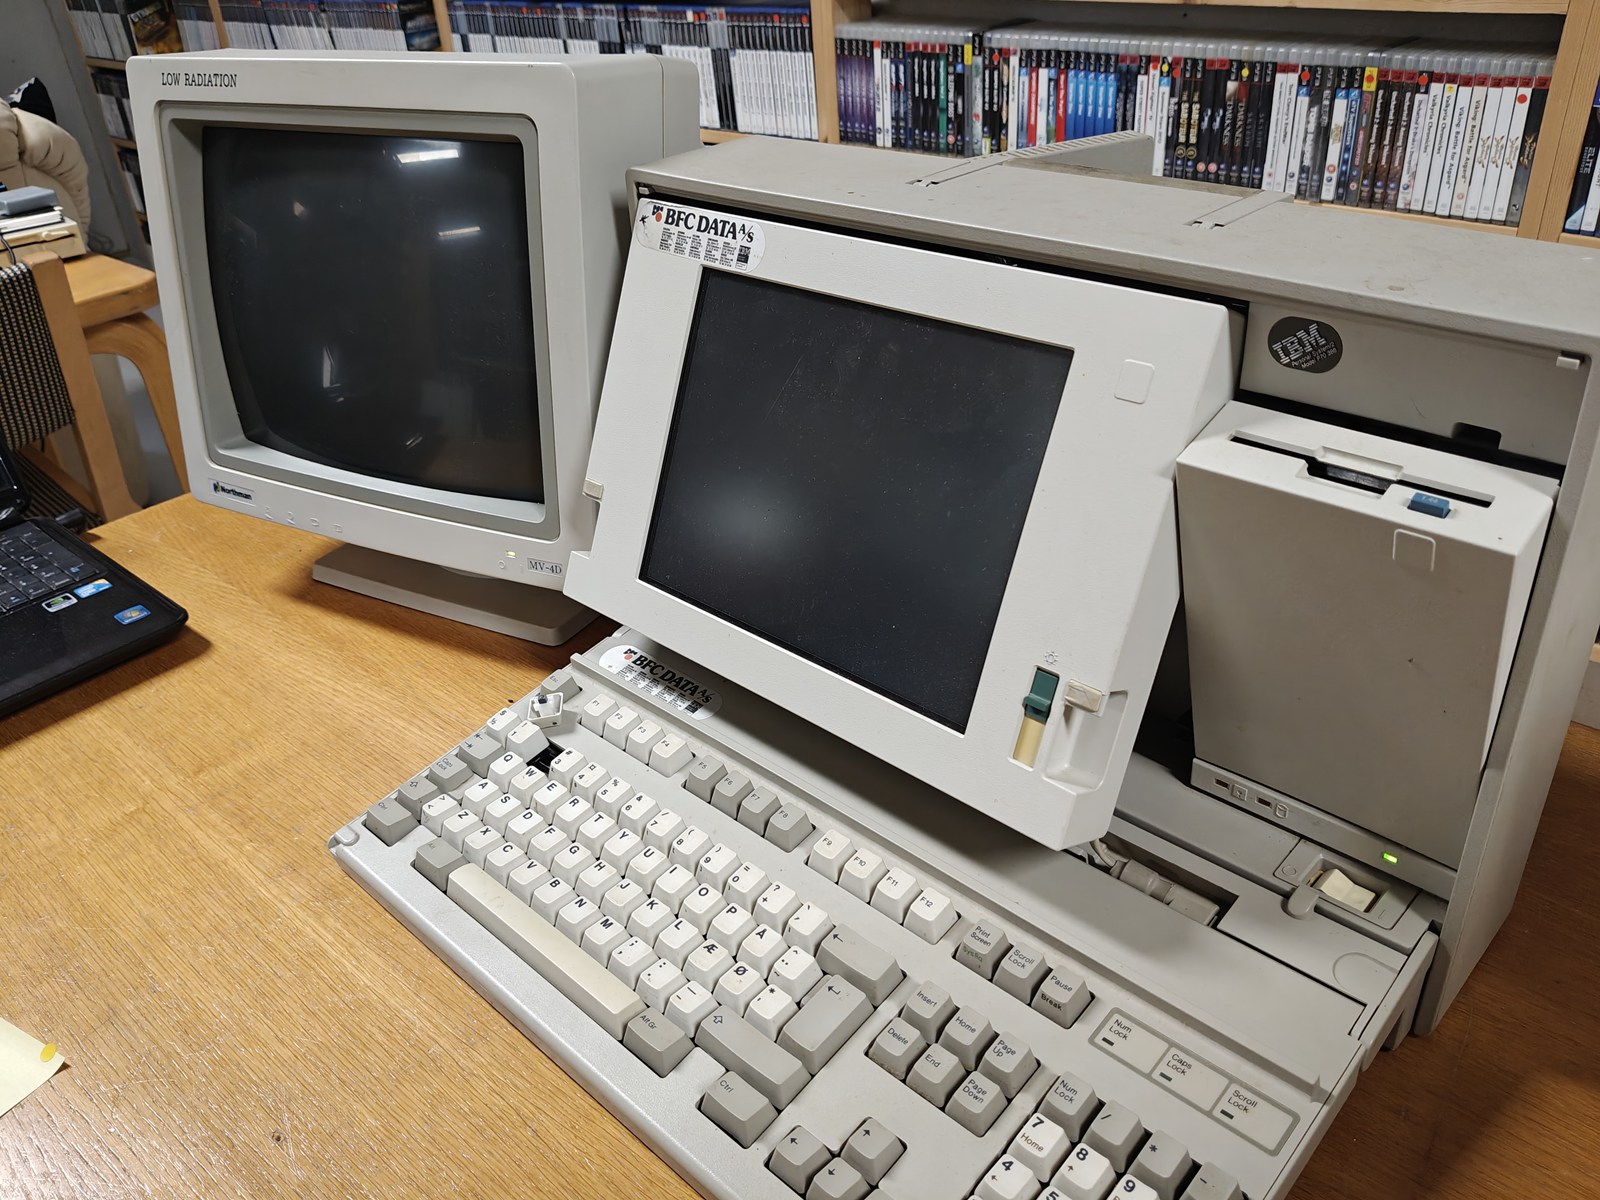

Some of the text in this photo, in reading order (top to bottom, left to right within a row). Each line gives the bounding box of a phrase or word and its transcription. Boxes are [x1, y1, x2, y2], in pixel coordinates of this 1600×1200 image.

[162, 73, 237, 87] LOW RADIATION
[1178, 102, 1189, 143] SABOTEUR
[1189, 103, 1200, 144] SABOTEUR
[1423, 94, 1438, 153] Valkyria Chronicles
[1437, 95, 1452, 155] Valkyria Chronicles
[1468, 124, 1476, 143] Battle
[1452, 131, 1460, 150] Battle
[1584, 147, 1596, 174] ELITE
[664, 208, 754, 243] BFC DATA A/S
[1272, 323, 1326, 364] IBM
[530, 561, 562, 574] MV-4D
[631, 655, 665, 676] BFC
[658, 670, 699, 696] DATA
[614, 712, 622, 720] F2
[637, 726, 646, 734] F3
[661, 739, 670, 747] F4
[503, 754, 513, 763] Q
[525, 768, 536, 777] W
[478, 782, 489, 790] A
[547, 783, 557, 791] E
[723, 776, 734, 786] F6
[501, 795, 511, 804] S
[569, 798, 580, 807] R
[750, 792, 761, 801] F7
[458, 811, 469, 819] Z
[522, 812, 533, 820] D
[594, 814, 604, 822] T
[778, 809, 789, 819] F8
[480, 827, 492, 836] X
[544, 827, 556, 835] F
[619, 831, 629, 840] Y
[822, 837, 833, 846] F9
[502, 844, 513, 853] C
[569, 846, 580, 854] G
[644, 848, 655, 858] U
[526, 861, 538, 870] V
[594, 862, 606, 871] H
[853, 856, 866, 867] F10
[549, 879, 561, 888] B
[886, 876, 899, 887] F11
[575, 898, 587, 908] N
[646, 900, 659, 910] K
[920, 896, 934, 908] F12
[726, 906, 738, 914] P
[600, 918, 614, 929] M
[674, 920, 683, 930] L
[974, 925, 991, 938] Print
[970, 931, 992, 947] Screen
[703, 943, 718, 954] Æ
[1007, 954, 1027, 970] Lock
[1013, 949, 1035, 966] Scroll
[734, 966, 748, 976] Ø
[1050, 974, 1073, 993] Pause
[916, 990, 938, 1007] Insert
[1040, 993, 1063, 1011] Break
[955, 1015, 977, 1034] Home
[1113, 1019, 1132, 1033] Num
[887, 1027, 909, 1045] Delete
[1109, 1025, 1129, 1041] Lock
[992, 1046, 1005, 1058] Up
[997, 1039, 1017, 1057] Page
[924, 1054, 941, 1069] End
[1166, 1060, 1188, 1076] Lock
[1171, 1053, 1193, 1070] Caps
[718, 1079, 735, 1094] Ctrl
[968, 1079, 988, 1096] Page
[1059, 1079, 1078, 1096] Num
[962, 1085, 985, 1104] Down
[1054, 1085, 1075, 1104] Lock
[1232, 1089, 1258, 1108] Scroll
[1228, 1096, 1250, 1114] Lock
[1031, 1116, 1045, 1129] 7
[1020, 1132, 1045, 1153] Home
[1076, 1147, 1089, 1162] 8
[1001, 1160, 1014, 1172] 4
[1123, 1179, 1136, 1193] 9
